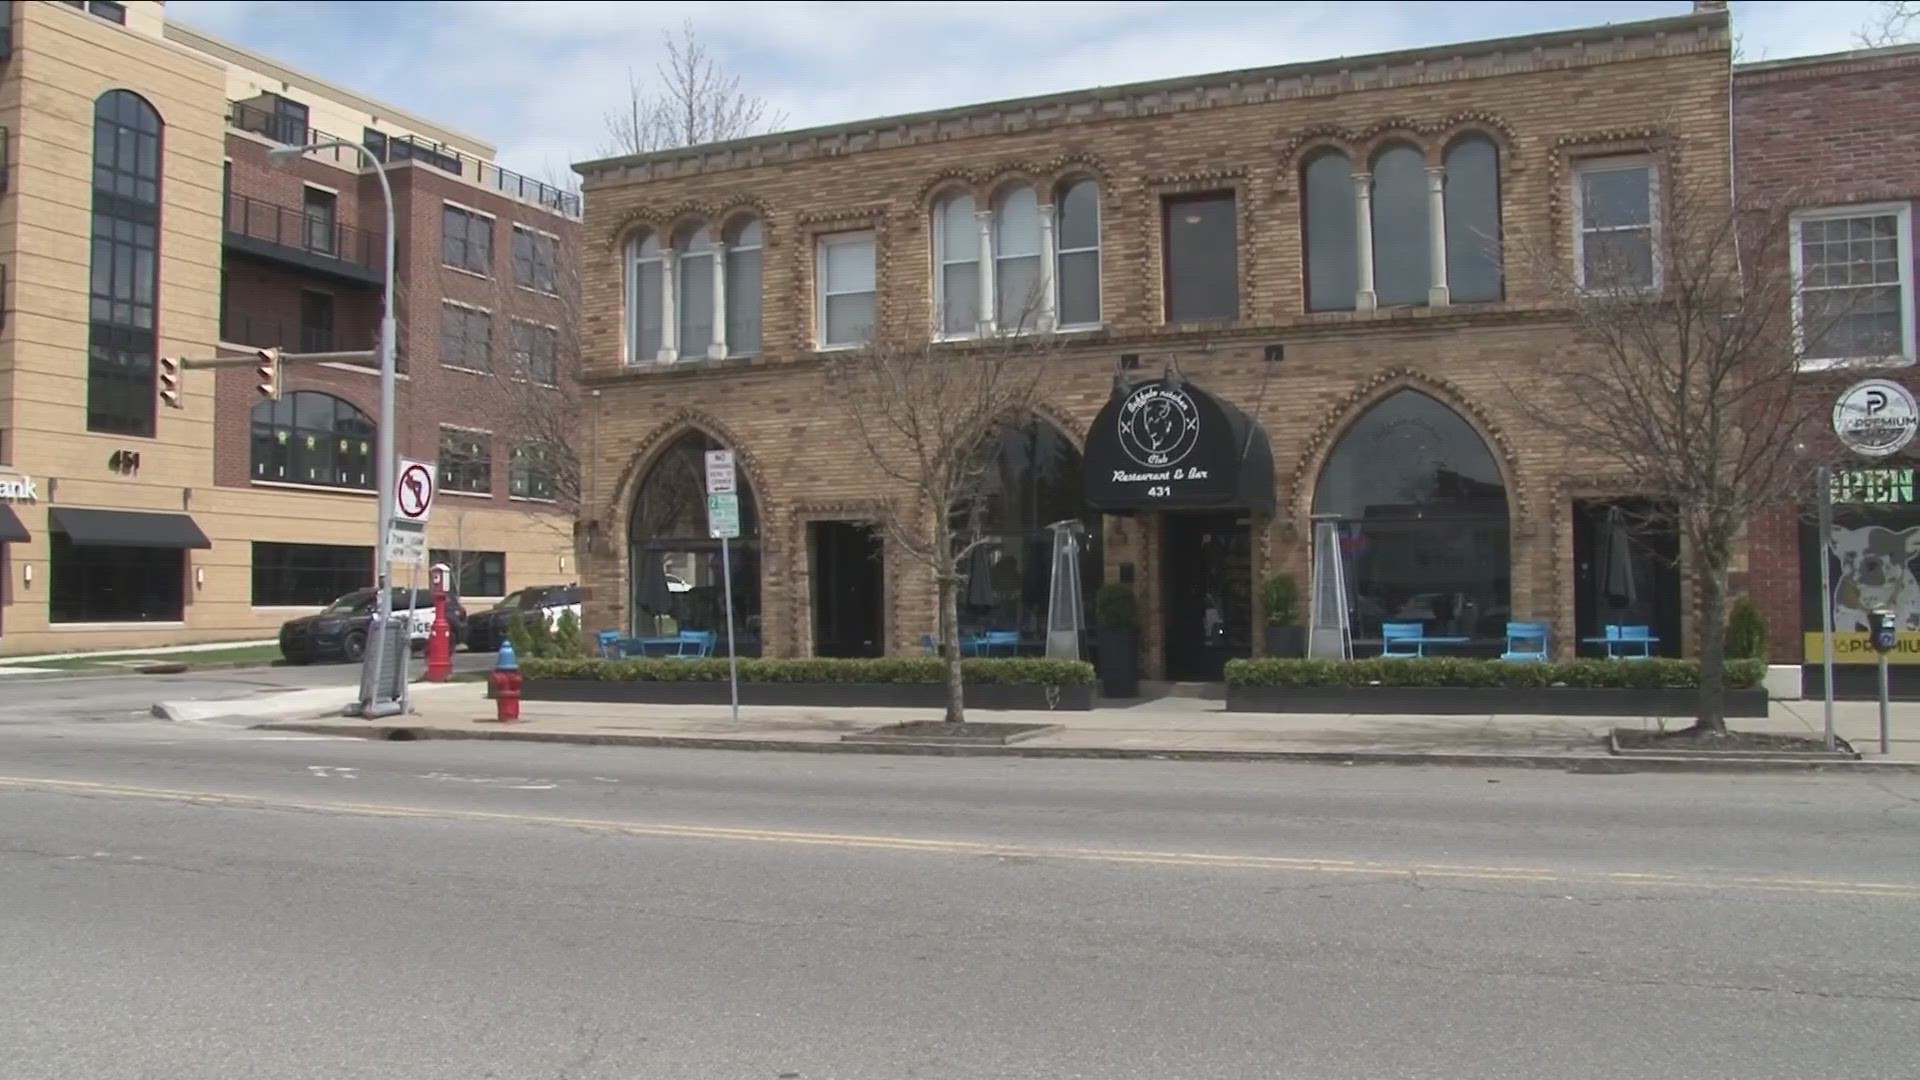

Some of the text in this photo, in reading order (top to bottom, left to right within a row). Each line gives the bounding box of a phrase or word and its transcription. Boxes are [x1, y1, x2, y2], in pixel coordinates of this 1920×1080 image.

[1855, 416, 1917, 428] PREMIUM
[1147, 453, 1169, 464] Club
[1112, 466, 1208, 482] Restaurant & Bar
[1147, 486, 1171, 497] 431
[1830, 469, 1914, 504] OPEN
[1850, 639, 1920, 653] PRMIU
